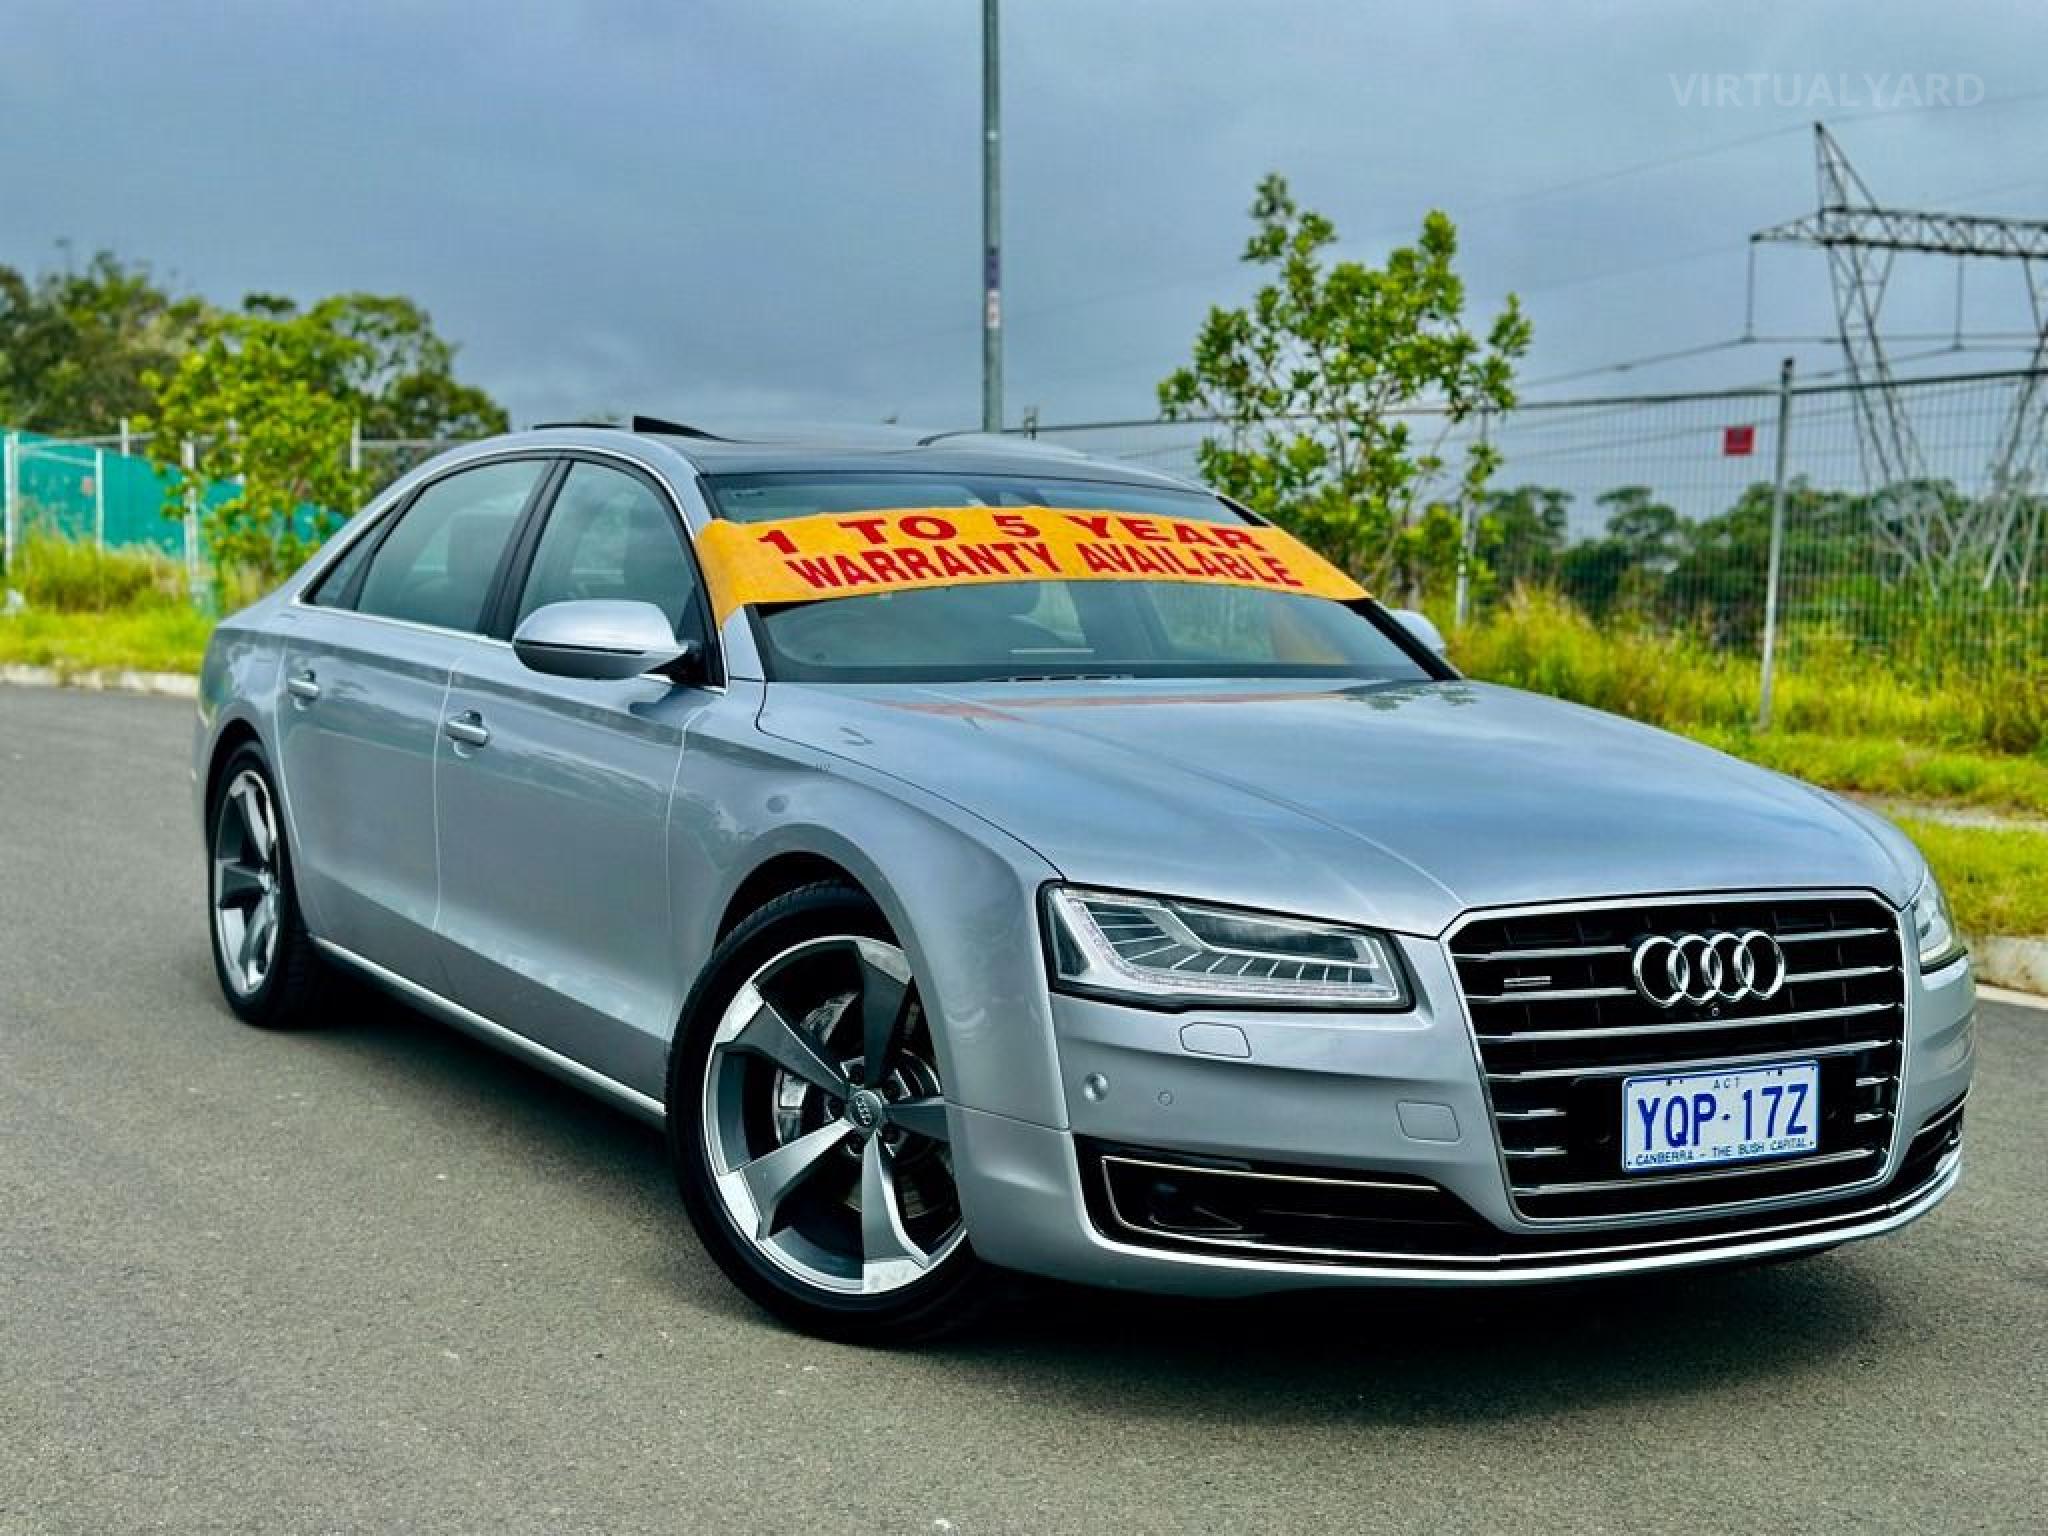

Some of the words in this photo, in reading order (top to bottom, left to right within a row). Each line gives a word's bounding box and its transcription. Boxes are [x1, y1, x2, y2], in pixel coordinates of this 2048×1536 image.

[757, 529, 799, 554] 1
[837, 515, 958, 544] TO
[992, 514, 1041, 537] 5
[1064, 515, 1269, 551] YEAR
[784, 541, 1062, 588] WARRANTY
[1075, 542, 1304, 587] AVAILABLE
[1713, 1077, 1741, 1089] ACT
[1635, 1149, 1695, 1166] CANBERRA
[1711, 1144, 1732, 1157] THE
